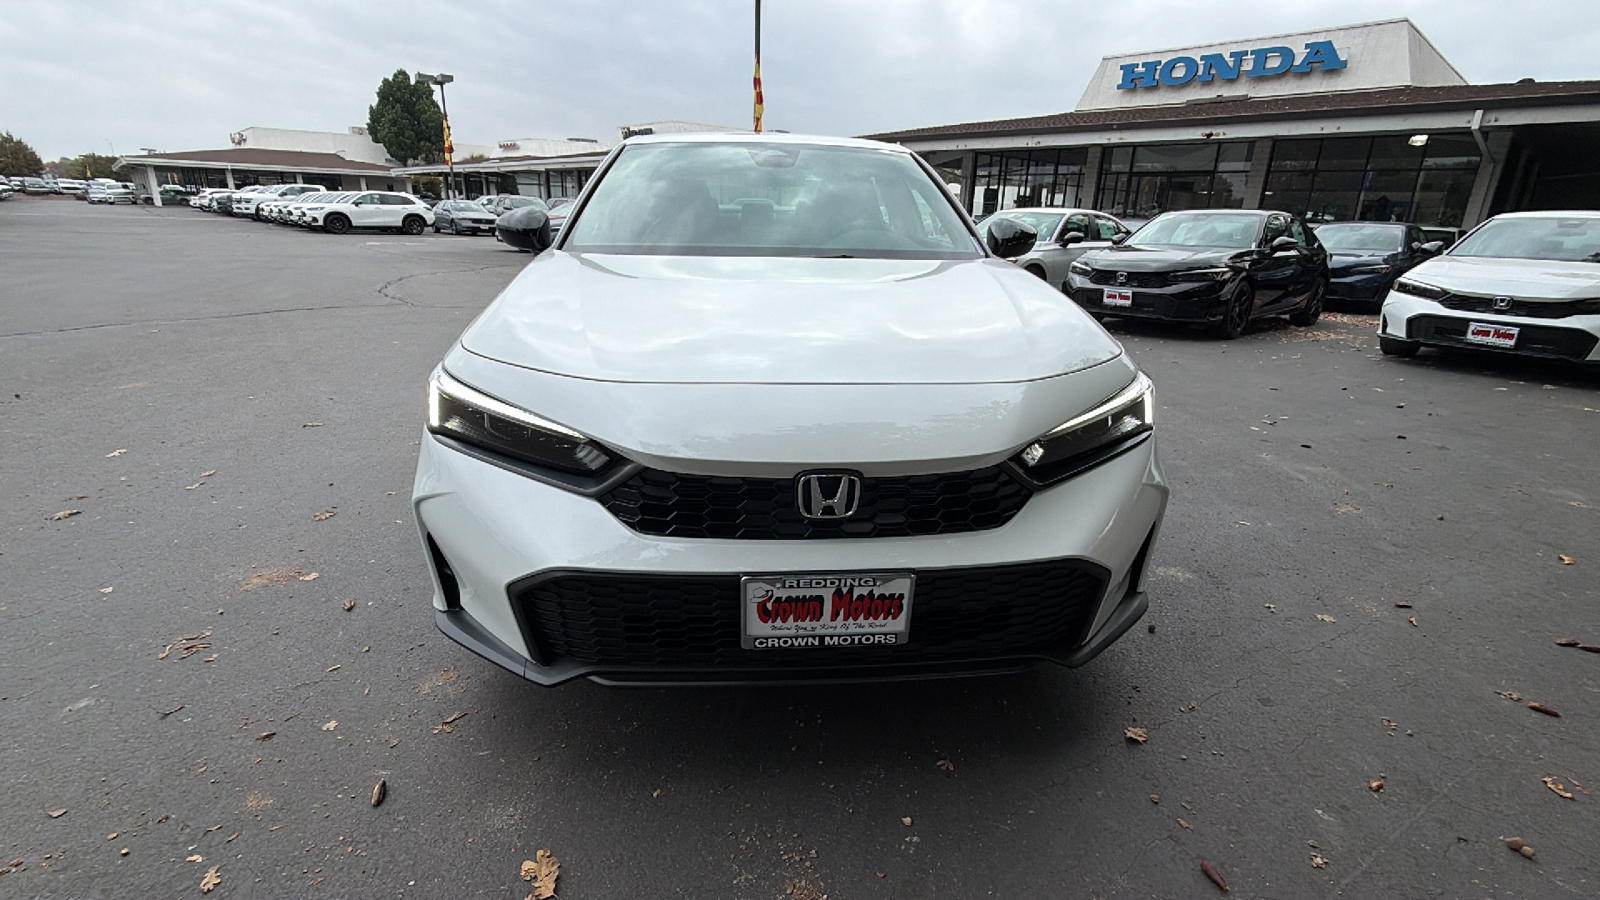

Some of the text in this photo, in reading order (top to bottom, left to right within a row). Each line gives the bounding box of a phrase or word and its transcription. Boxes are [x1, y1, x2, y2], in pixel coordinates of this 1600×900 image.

[1116, 40, 1348, 90] HONDA
[785, 578, 874, 588] REDDING
[757, 588, 905, 624] Crown Motors
[820, 622, 837, 632] King
[840, 622, 851, 631] Of
[868, 621, 888, 629] Road
[754, 634, 896, 648] CROWN MOTORS
